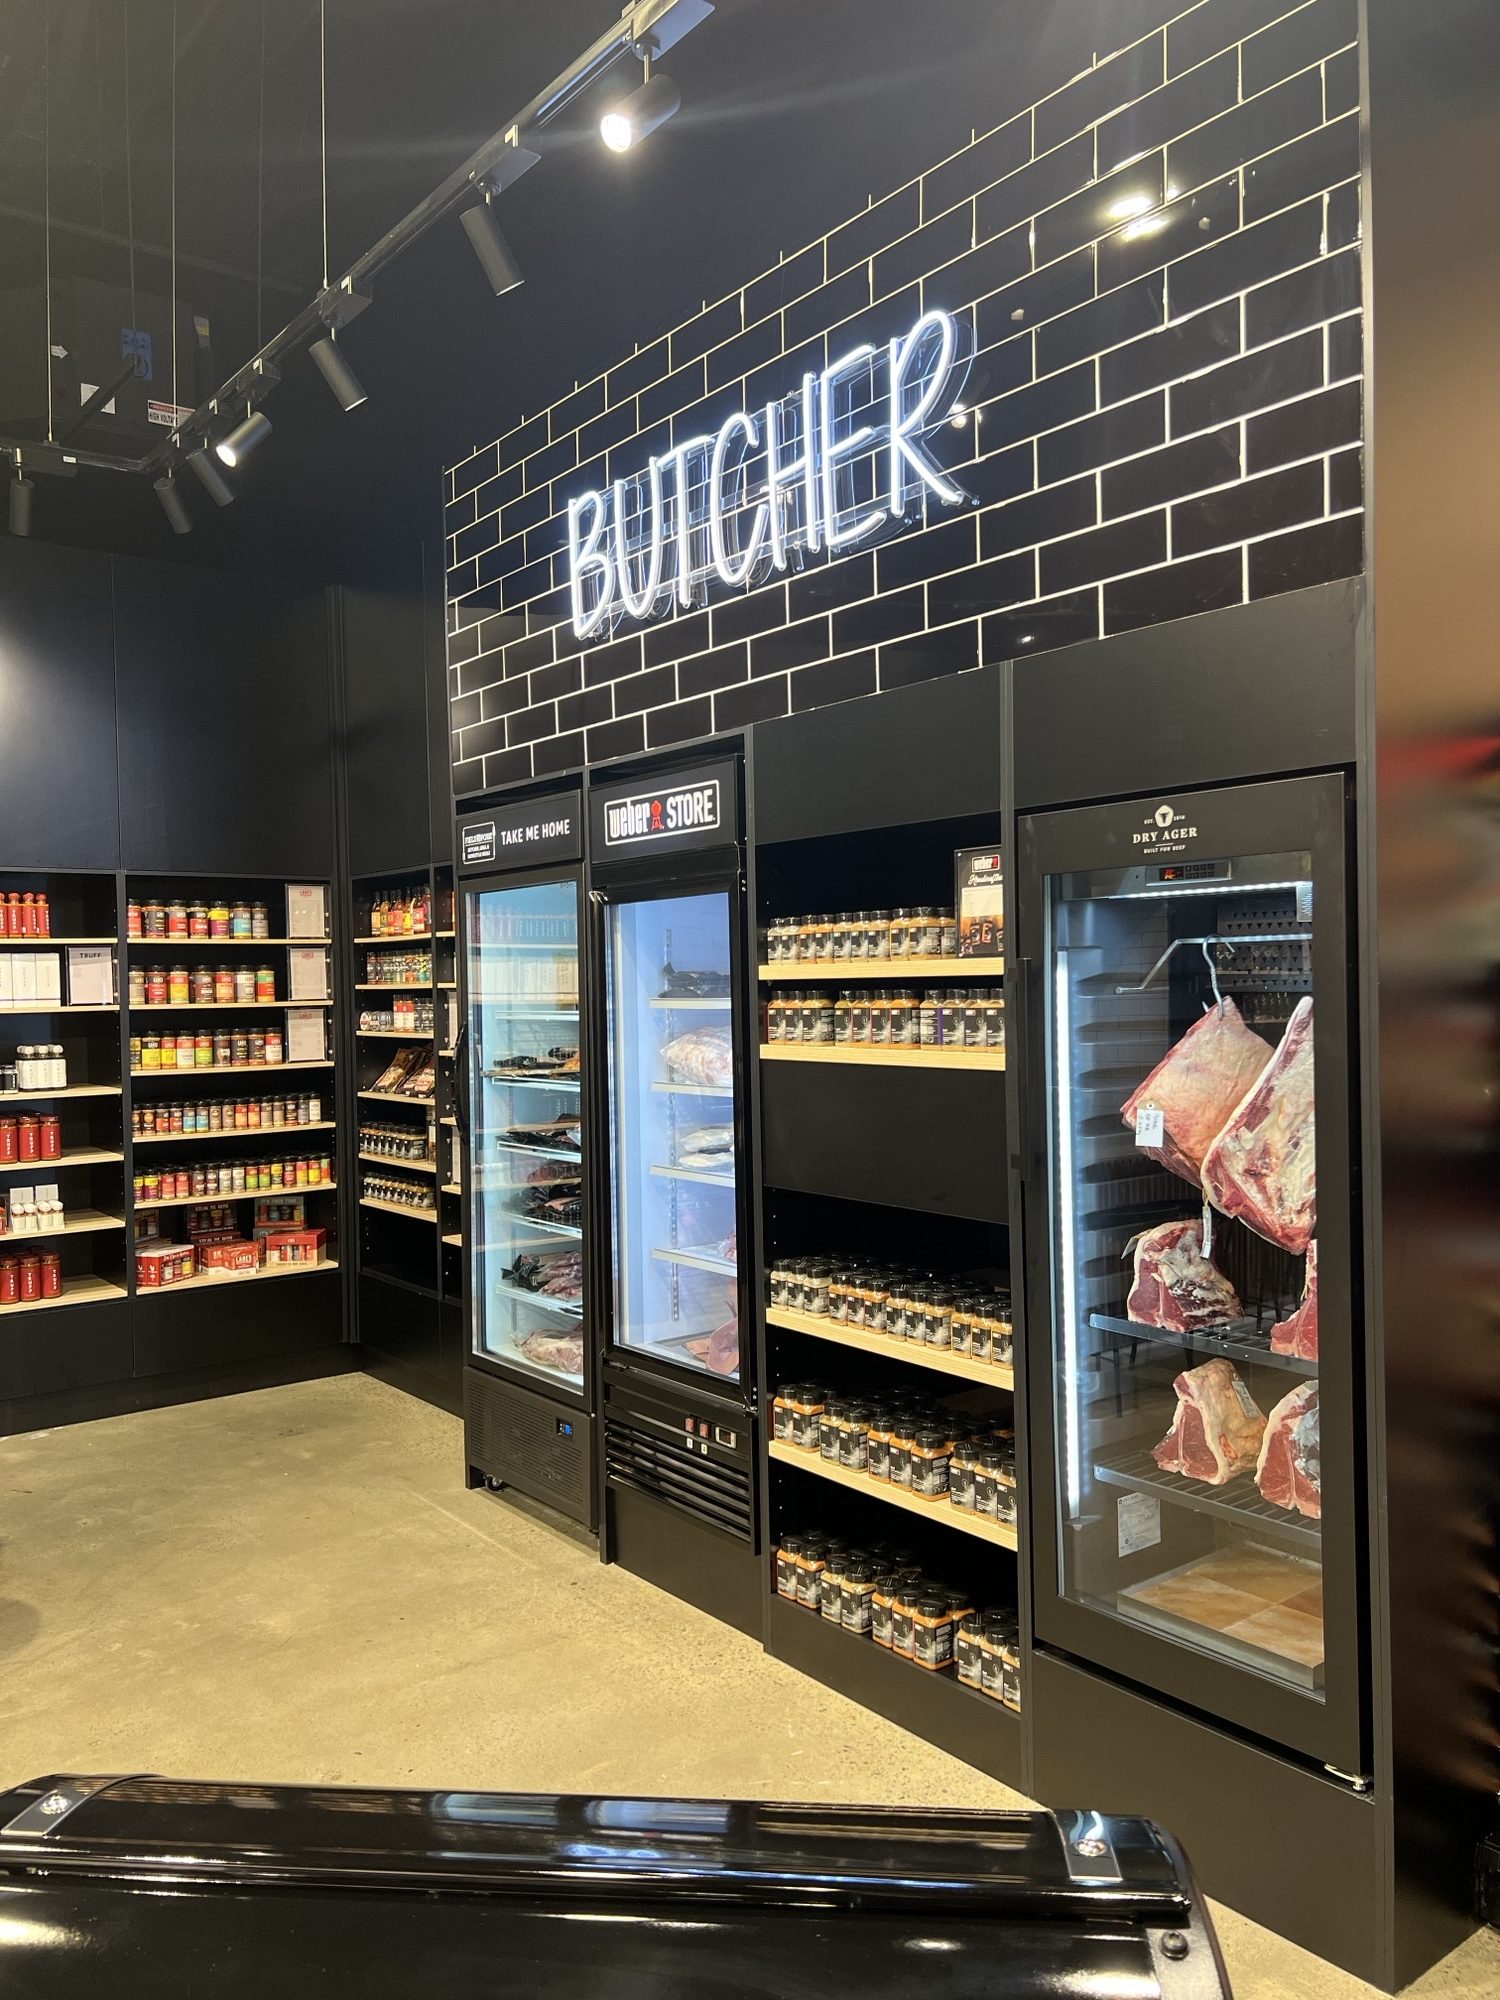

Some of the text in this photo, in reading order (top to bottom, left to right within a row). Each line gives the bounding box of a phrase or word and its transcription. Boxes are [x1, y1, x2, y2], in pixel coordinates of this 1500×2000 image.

[568, 309, 967, 641] BUTCHER
[501, 818, 571, 846] TAKE ME HOME
[608, 788, 715, 838] weber STORE
[1132, 827, 1198, 844] DRY AGER
